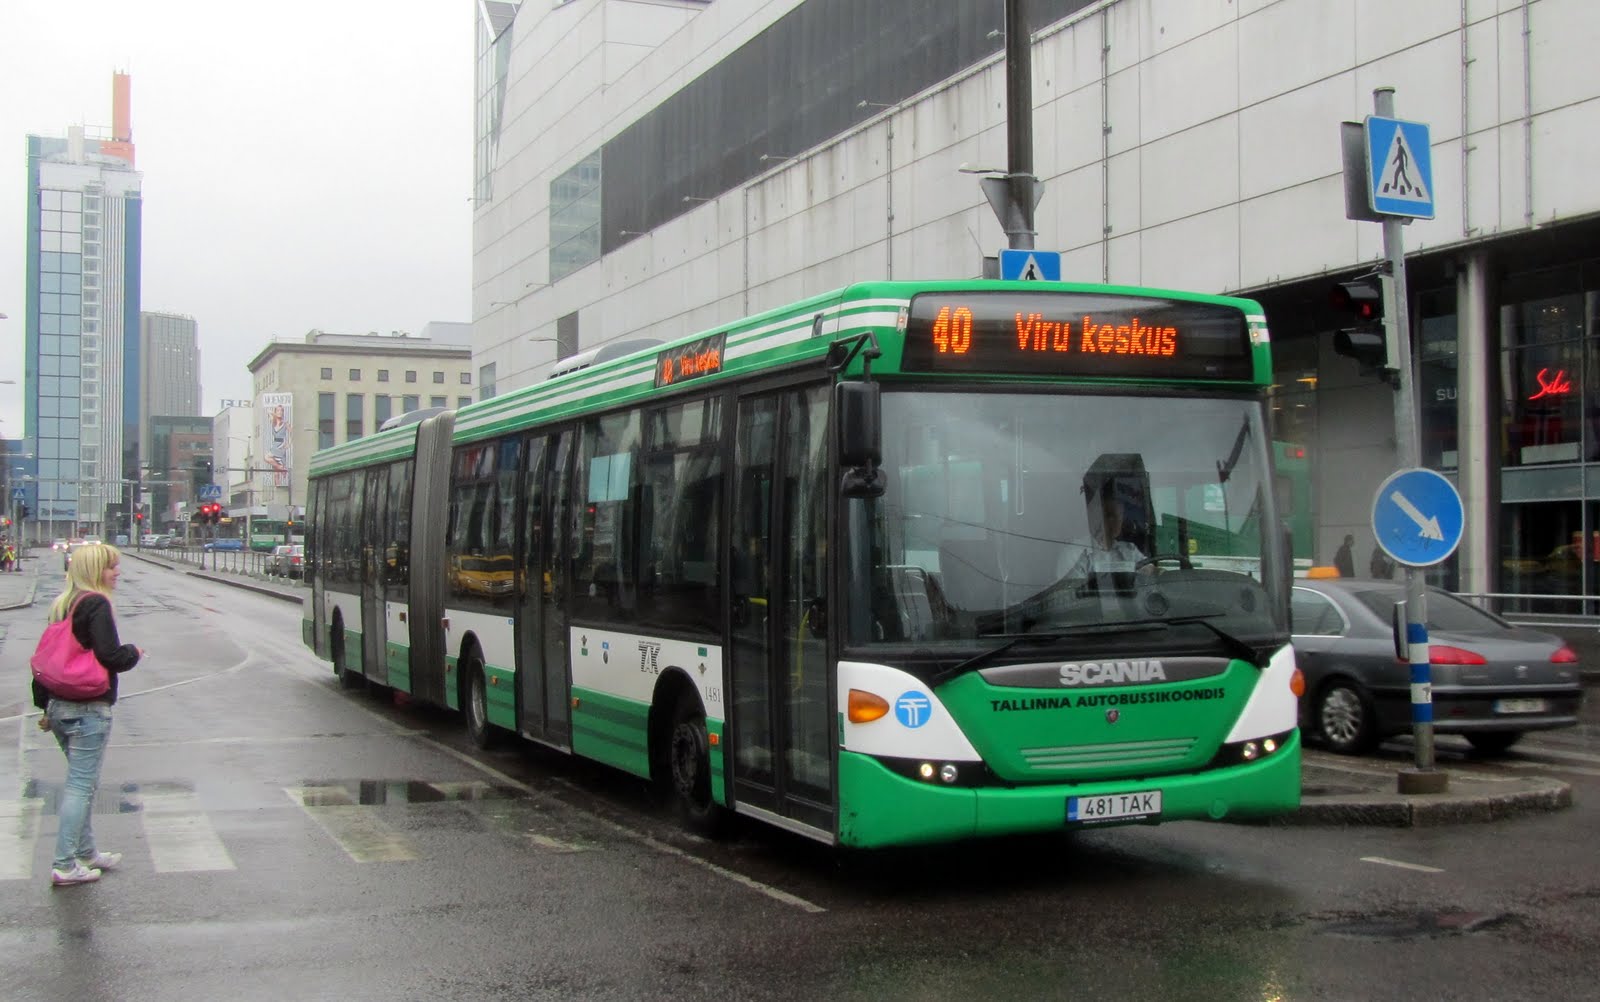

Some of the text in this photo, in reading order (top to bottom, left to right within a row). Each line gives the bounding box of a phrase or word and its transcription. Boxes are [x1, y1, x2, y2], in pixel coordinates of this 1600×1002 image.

[933, 306, 1176, 356] 40 Viru keskus
[1059, 660, 1167, 686] SCANIA
[705, 686, 721, 703] 1481
[991, 687, 1225, 713] TALLINNA AUTOBUSSIKOONDIS
[1085, 794, 1154, 816] 481 TAK
